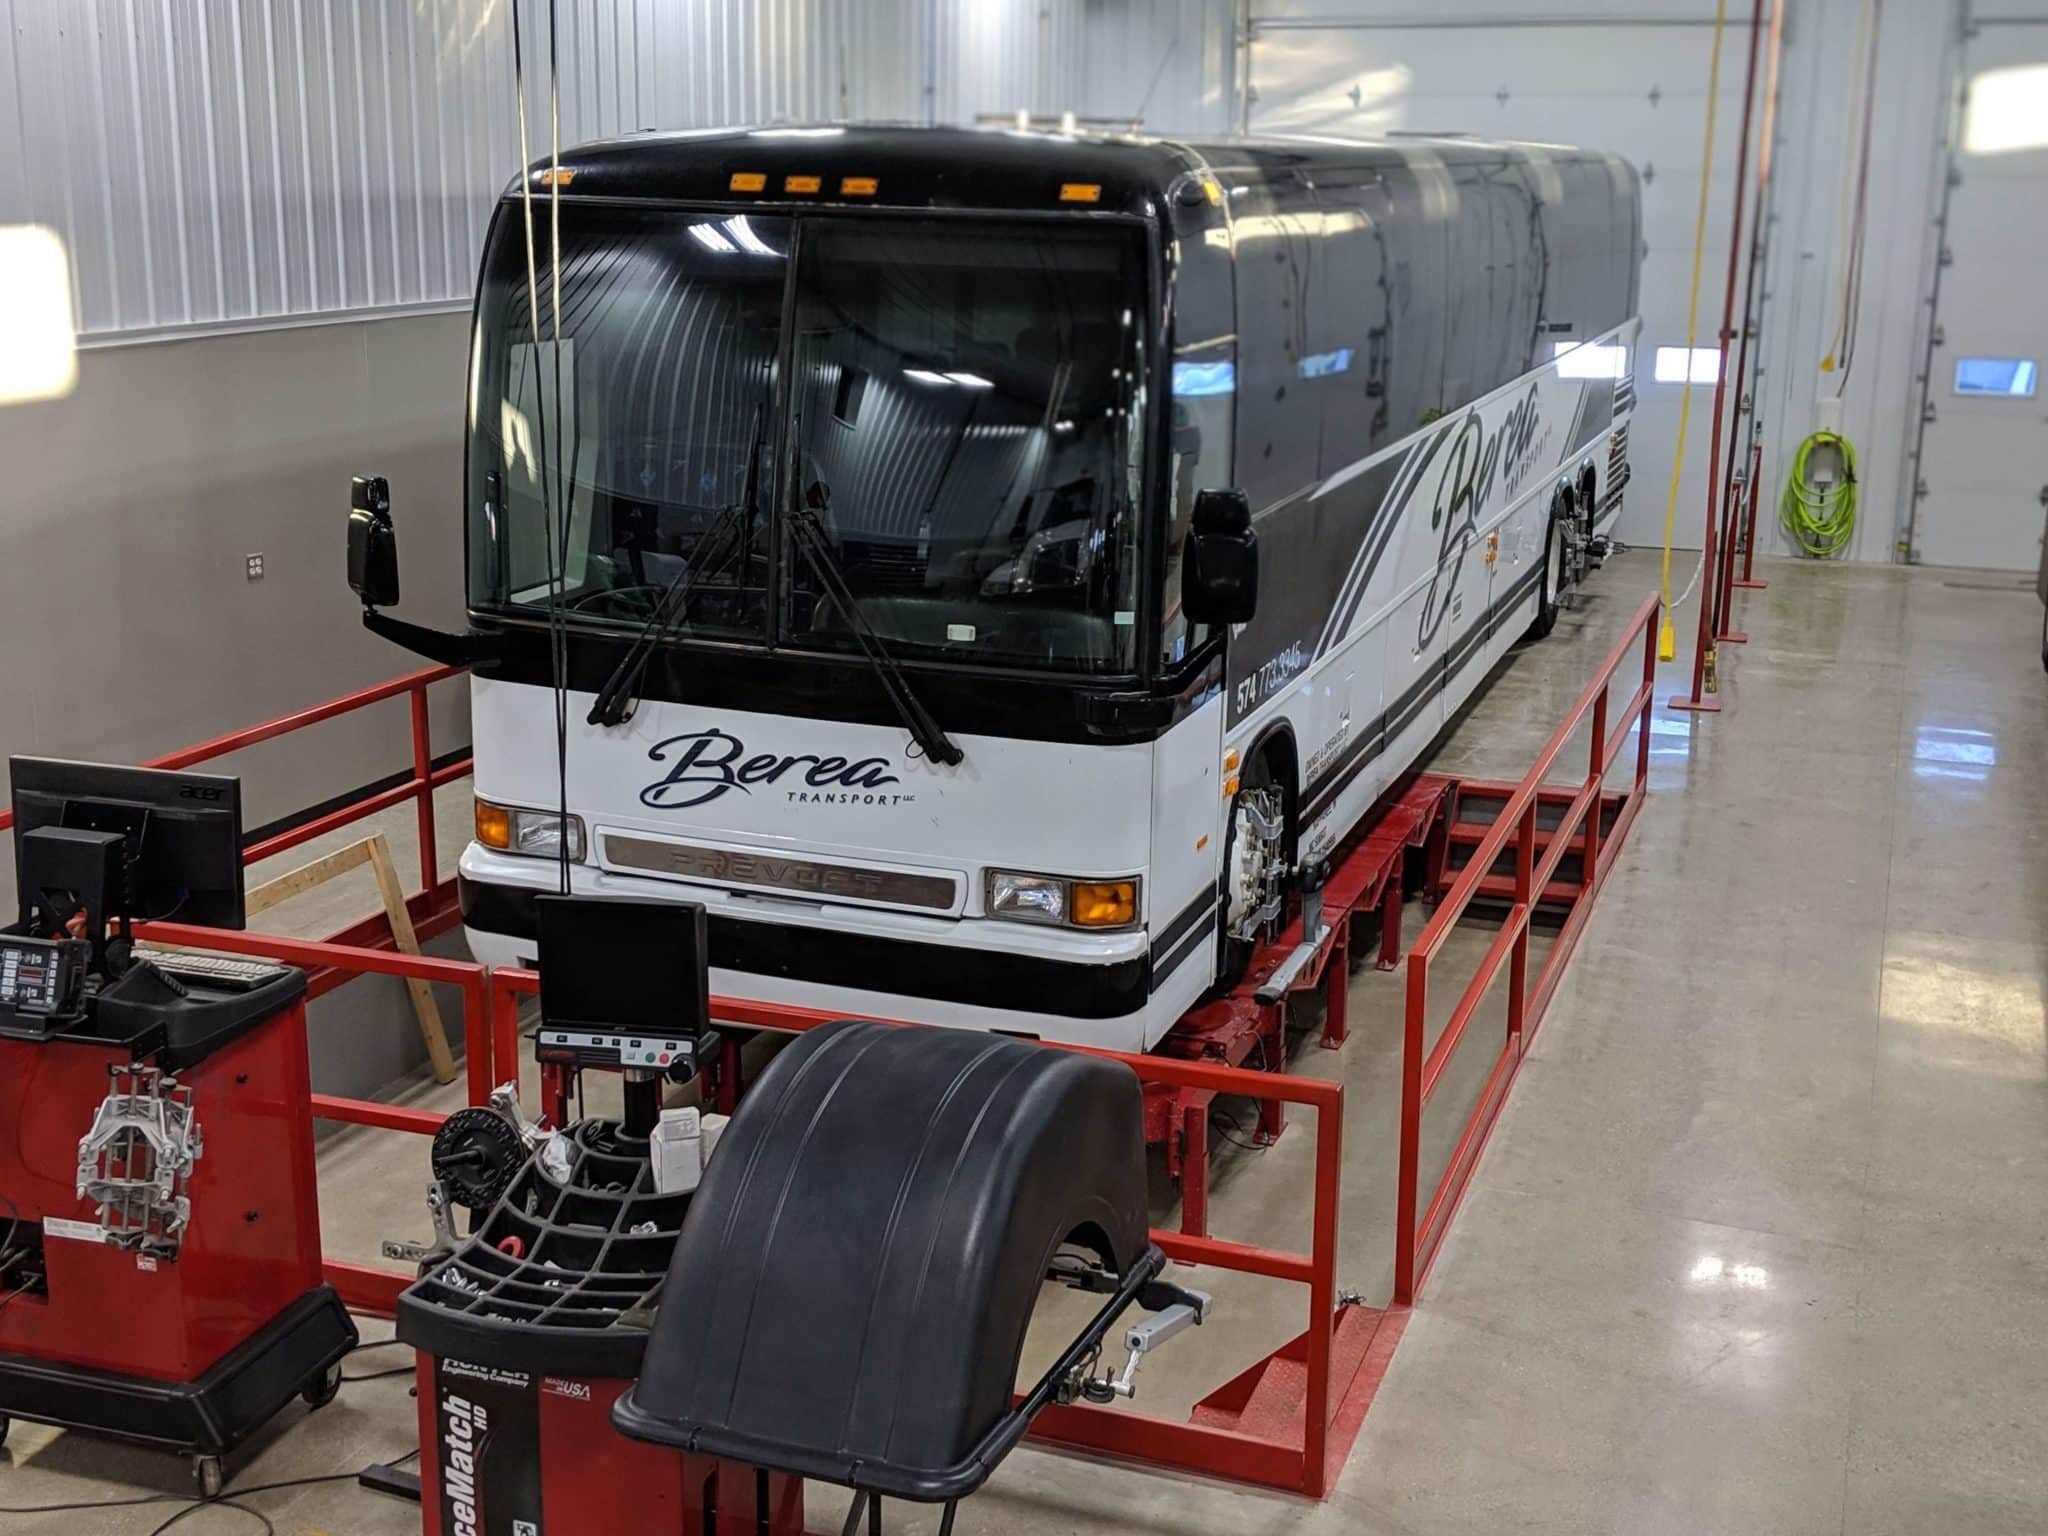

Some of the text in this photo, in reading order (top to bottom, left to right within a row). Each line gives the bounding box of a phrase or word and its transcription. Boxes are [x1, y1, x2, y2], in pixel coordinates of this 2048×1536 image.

[1237, 672, 1256, 714] 574
[640, 728, 899, 809] Berea
[179, 784, 224, 801] acer
[787, 791, 902, 805] TRANSPORT
[442, 1366, 488, 1381] Engineering
[490, 1373, 529, 1389] Company
[563, 1381, 590, 1400] USA
[473, 1405, 488, 1430] HD
